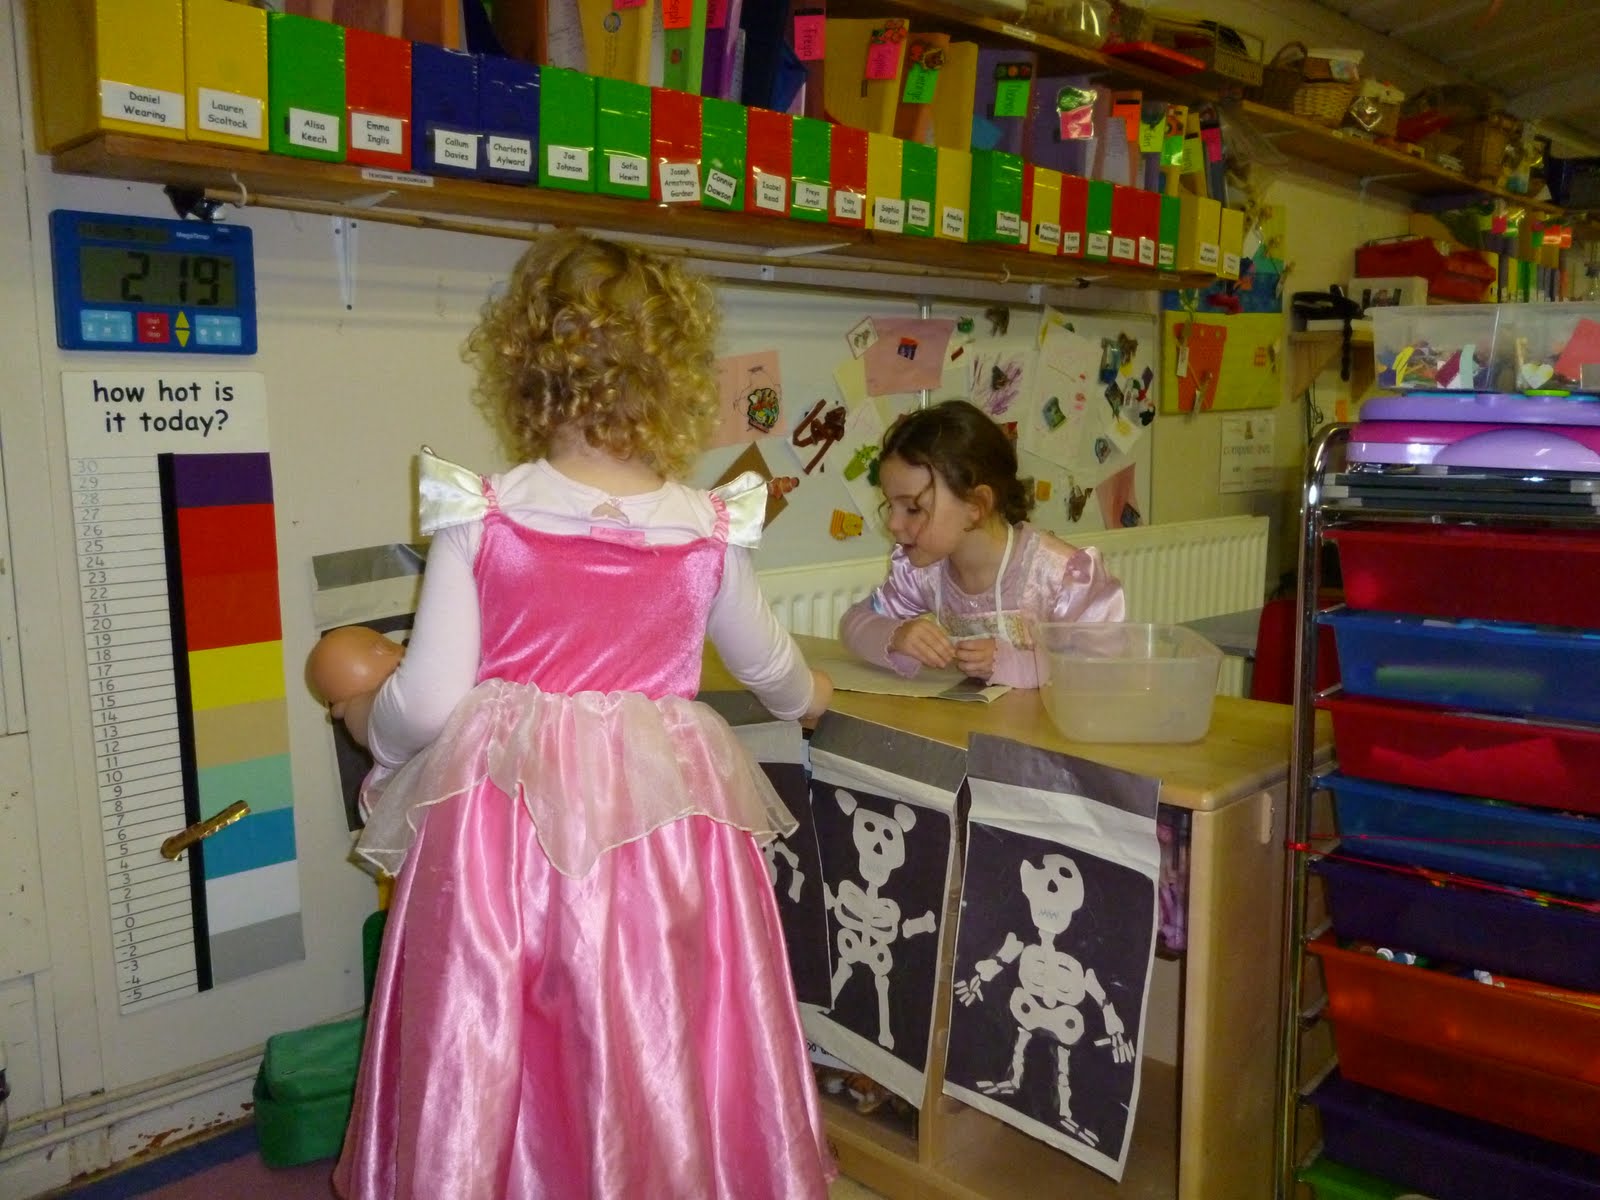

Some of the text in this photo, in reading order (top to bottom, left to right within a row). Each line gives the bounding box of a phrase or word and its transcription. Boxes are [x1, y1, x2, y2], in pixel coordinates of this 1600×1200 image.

[129, 91, 160, 104] Daniel
[123, 105, 166, 122] Wearing
[211, 101, 244, 114] Lauren
[208, 113, 248, 129] Scoltock
[304, 120, 325, 131] Alisa
[366, 121, 390, 132] Emma
[301, 131, 327, 144] Keech
[367, 134, 390, 145] Inglis
[445, 137, 469, 149] Callum
[445, 150, 469, 161] Davies
[493, 143, 528, 155] Charlotte
[496, 156, 526, 167] Aylward
[556, 162, 583, 173] Johnson
[621, 162, 638, 171] Sofia
[670, 168, 690, 176] Joseph
[711, 172, 733, 188] Connie
[706, 185, 732, 200] Dawson
[93, 379, 234, 402] how hot is
[105, 408, 229, 437] it today?
[77, 460, 98, 474] 30
[79, 477, 98, 489] 29
[80, 492, 100, 505] 28
[82, 508, 100, 521] 27
[82, 524, 103, 537] 26
[84, 540, 104, 553] 25
[86, 556, 105, 568] 24
[88, 571, 107, 584] 23
[90, 587, 108, 600] 22
[92, 603, 108, 616] 21
[92, 618, 112, 631] 20
[94, 633, 112, 647] 19
[96, 649, 112, 662] 18
[97, 664, 112, 677] 17
[99, 680, 115, 692] 16
[100, 695, 116, 708] 15
[102, 710, 117, 723] 14
[103, 725, 118, 738] 13
[104, 740, 120, 753] 12
[106, 756, 118, 768] 11
[106, 770, 122, 783] 10
[113, 785, 123, 797] 9
[114, 800, 123, 812] 8
[116, 814, 125, 826] 7
[117, 829, 127, 841] 6
[120, 843, 129, 856] 5
[120, 860, 128, 871] 4
[123, 873, 132, 885] 3
[124, 888, 132, 899] 2
[126, 903, 131, 913] 1
[125, 916, 135, 928] 0
[121, 931, 133, 943] -1
[122, 945, 137, 957] -2
[123, 959, 139, 972] -3
[126, 975, 141, 987] -4
[127, 988, 143, 1000] -5
